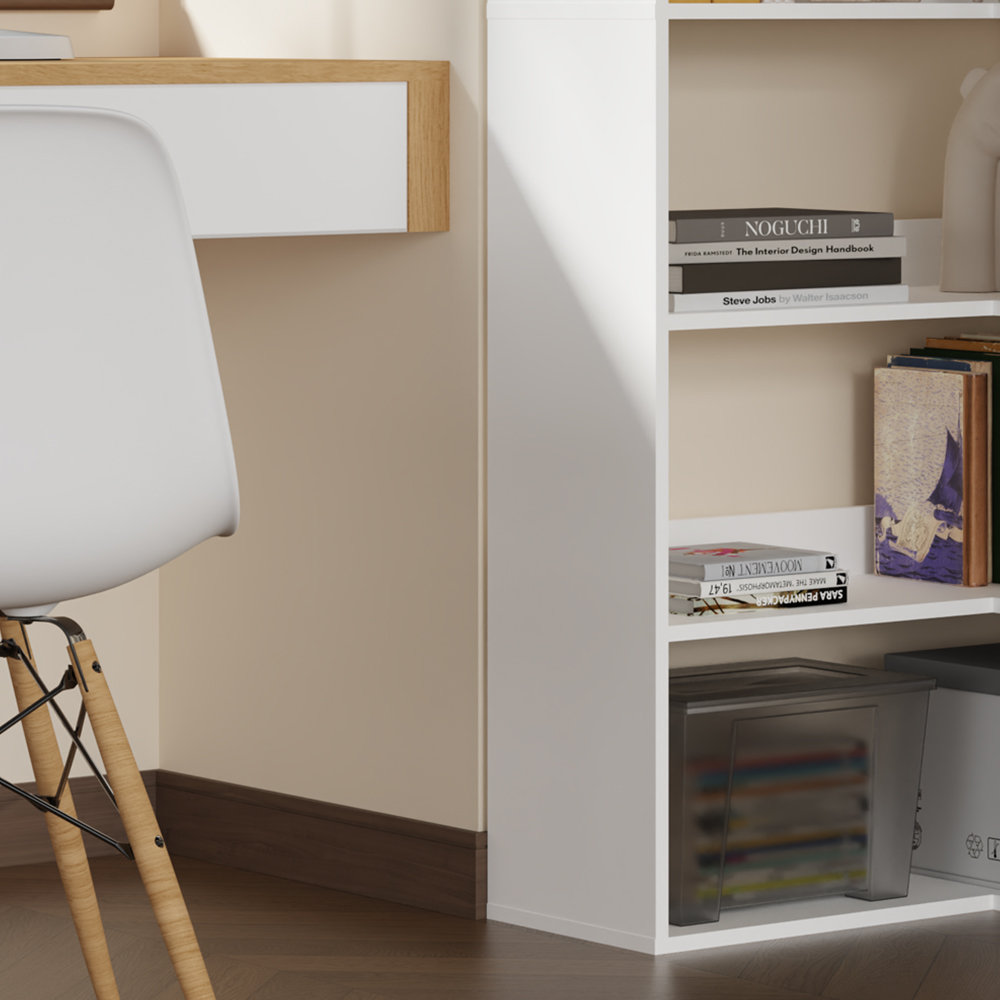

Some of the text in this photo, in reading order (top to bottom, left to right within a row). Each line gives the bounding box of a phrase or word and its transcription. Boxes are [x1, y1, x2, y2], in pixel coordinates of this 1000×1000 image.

[745, 219, 828, 237] NOGUCHI
[755, 247, 789, 255] Interior
[791, 246, 823, 255] Design
[826, 244, 874, 253] Handbook
[723, 292, 868, 305] Steve Jobs by Walter Isaacson
[738, 558, 802, 576] MOOVEMENT
[809, 577, 826, 587] MAKE
[756, 589, 843, 606] SARA PENNYPACKER
